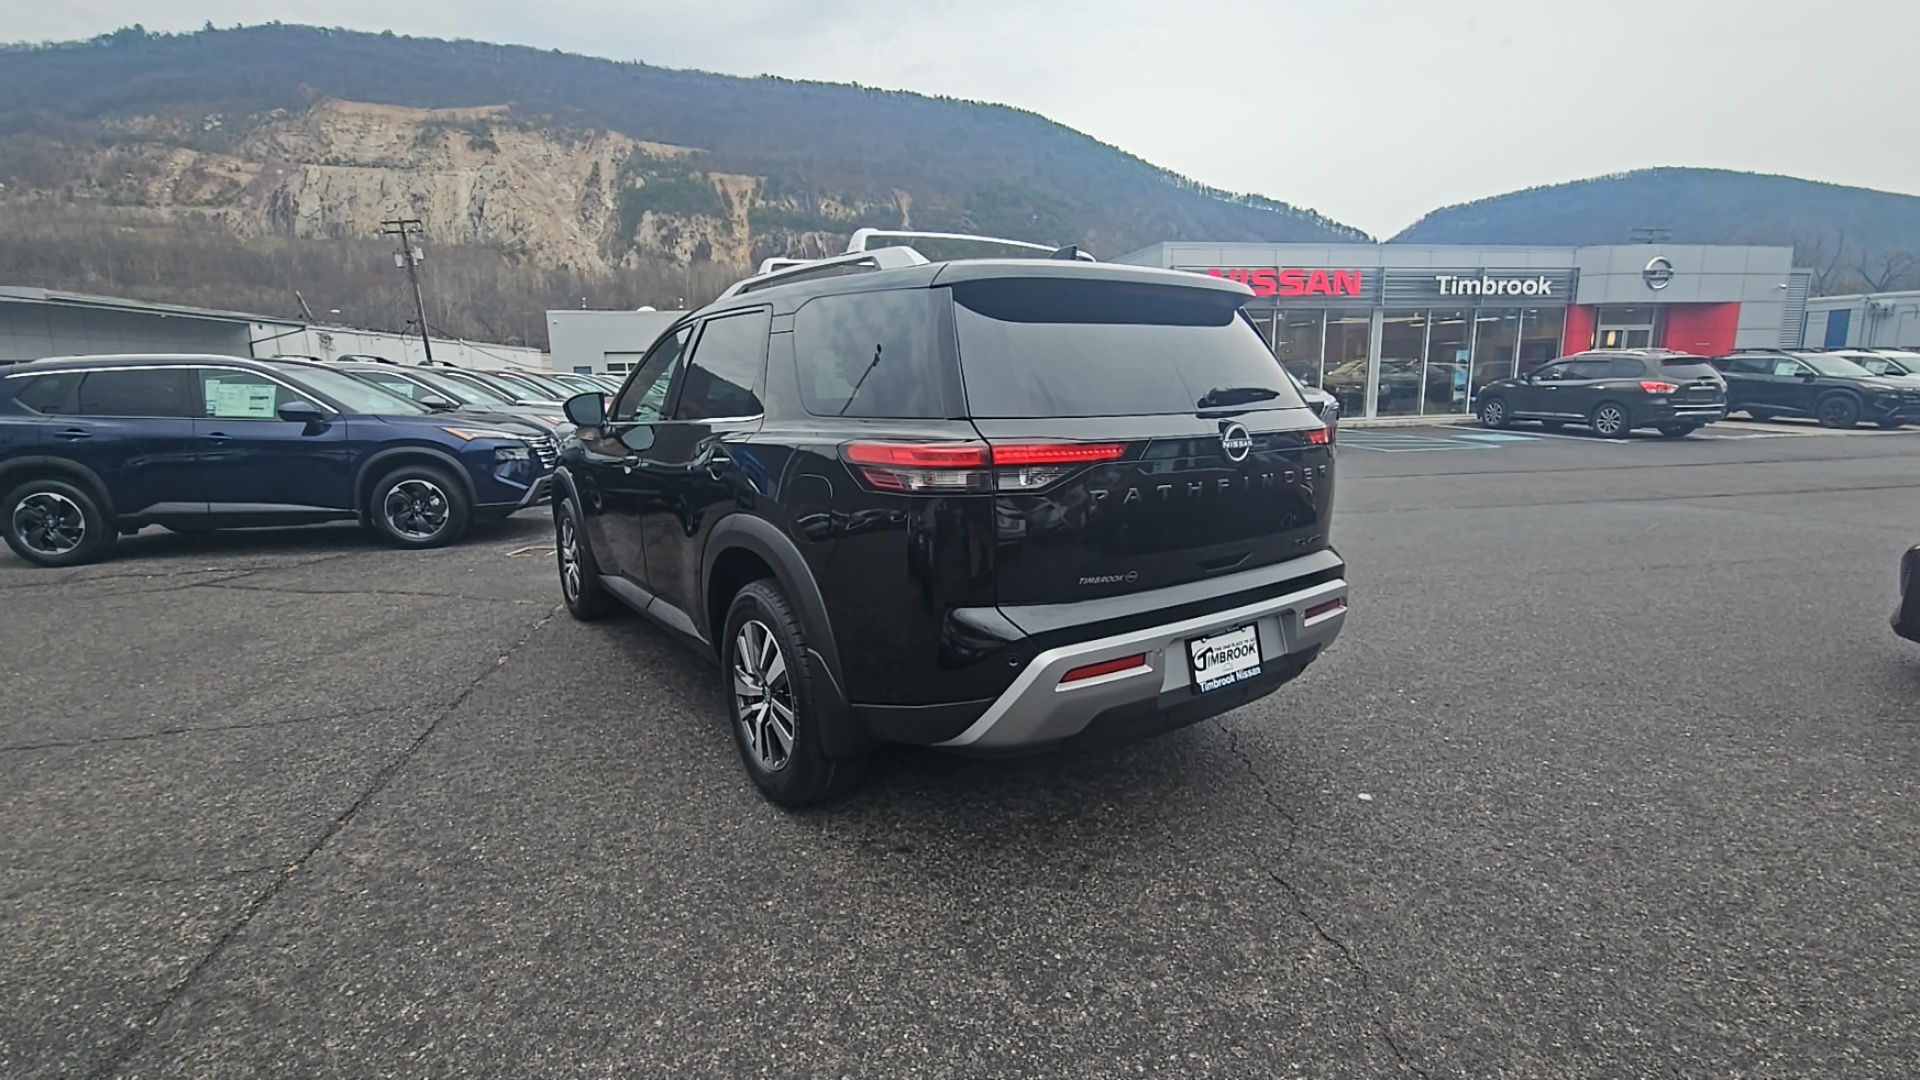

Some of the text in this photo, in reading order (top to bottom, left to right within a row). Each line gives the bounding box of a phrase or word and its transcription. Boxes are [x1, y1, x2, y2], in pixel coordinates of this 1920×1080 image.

[1435, 275, 1552, 295] Timbrook
[1222, 438, 1252, 449] NISSAN
[1089, 464, 1326, 506] PATHFINDER
[1079, 574, 1125, 585] TIMBROOK
[1194, 642, 1256, 671] TIMBROOK
[1200, 674, 1236, 693] Timbrook
[1236, 666, 1261, 682] Nissan
